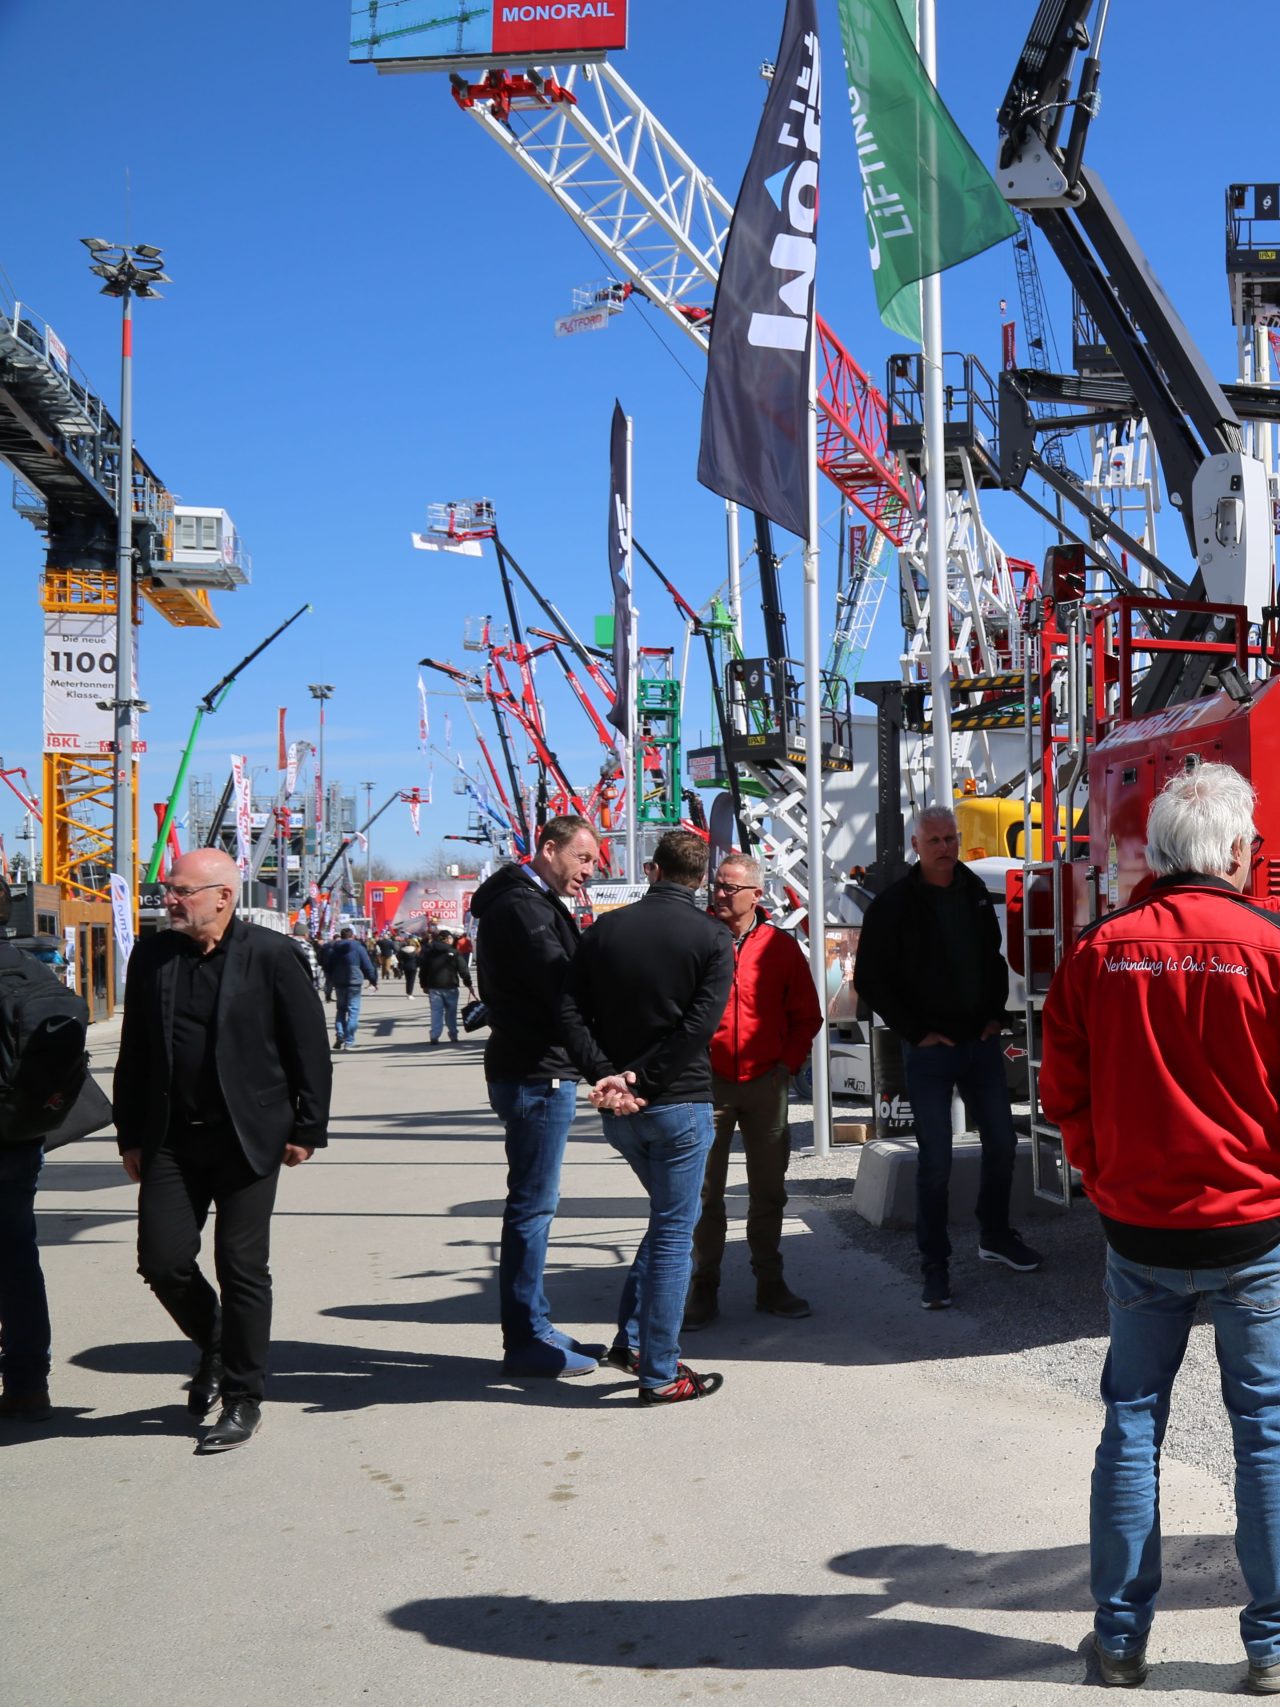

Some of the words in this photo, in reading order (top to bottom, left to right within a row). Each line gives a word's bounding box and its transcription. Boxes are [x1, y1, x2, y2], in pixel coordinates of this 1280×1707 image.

[501, 3, 615, 23] MONORAIL
[62, 634, 79, 643] Die
[51, 650, 117, 674] 1100
[50, 679, 115, 689] Metertonnen
[422, 901, 436, 909] GO
[438, 901, 457, 909] FOR
[410, 910, 457, 919] SOUTION
[1104, 955, 1164, 977] Verbinding
[1166, 956, 1178, 971] Is
[1181, 955, 1206, 972] Ons
[1208, 955, 1250, 977] Succes
[888, 1119, 915, 1128] LIFT
